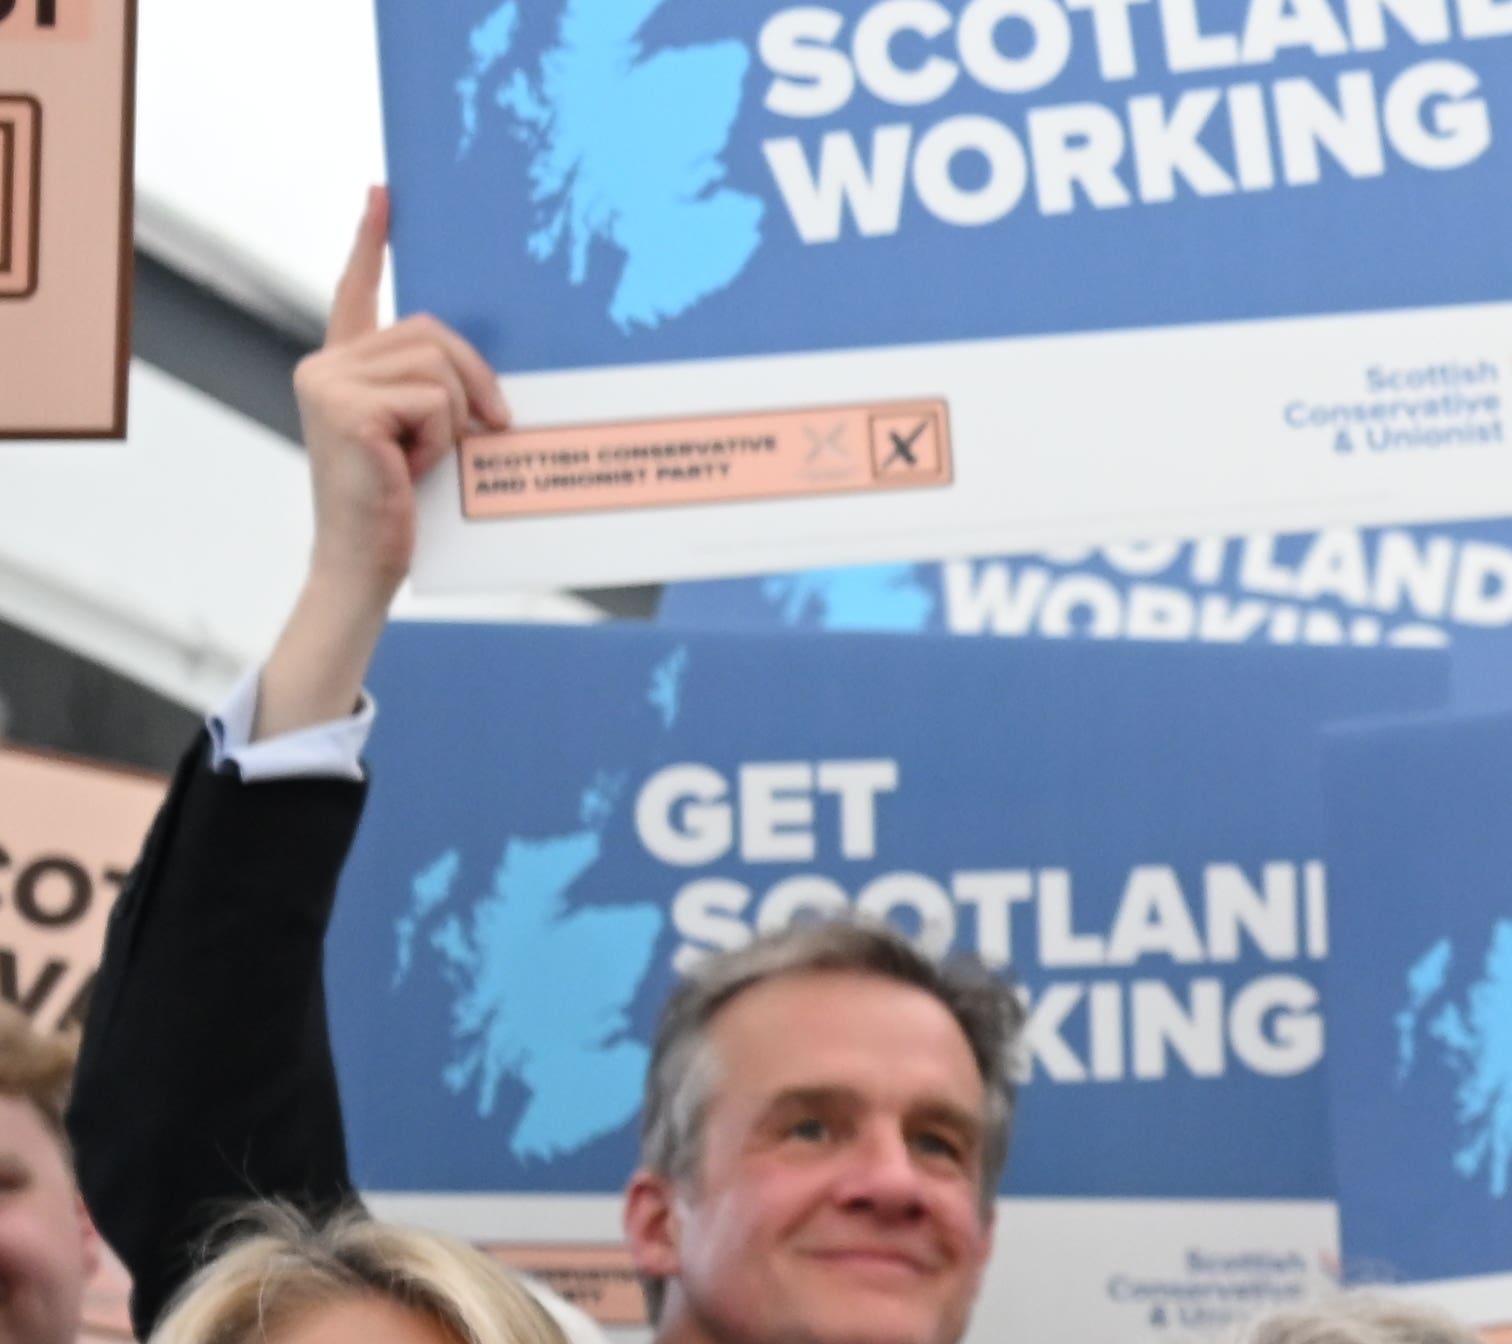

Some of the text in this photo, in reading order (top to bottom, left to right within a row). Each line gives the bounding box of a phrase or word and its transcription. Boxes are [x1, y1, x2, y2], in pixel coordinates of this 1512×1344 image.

[761, 59, 1493, 246] WORKING
[1365, 360, 1499, 393] Scottish
[1283, 390, 1501, 429] Conservative
[472, 435, 777, 472] SCOTTISH CONSERVATIVE
[1333, 420, 1503, 454] & Unionist
[656, 462, 731, 482] PARTY
[635, 759, 897, 867] GET
[1012, 974, 1325, 1083] KING
